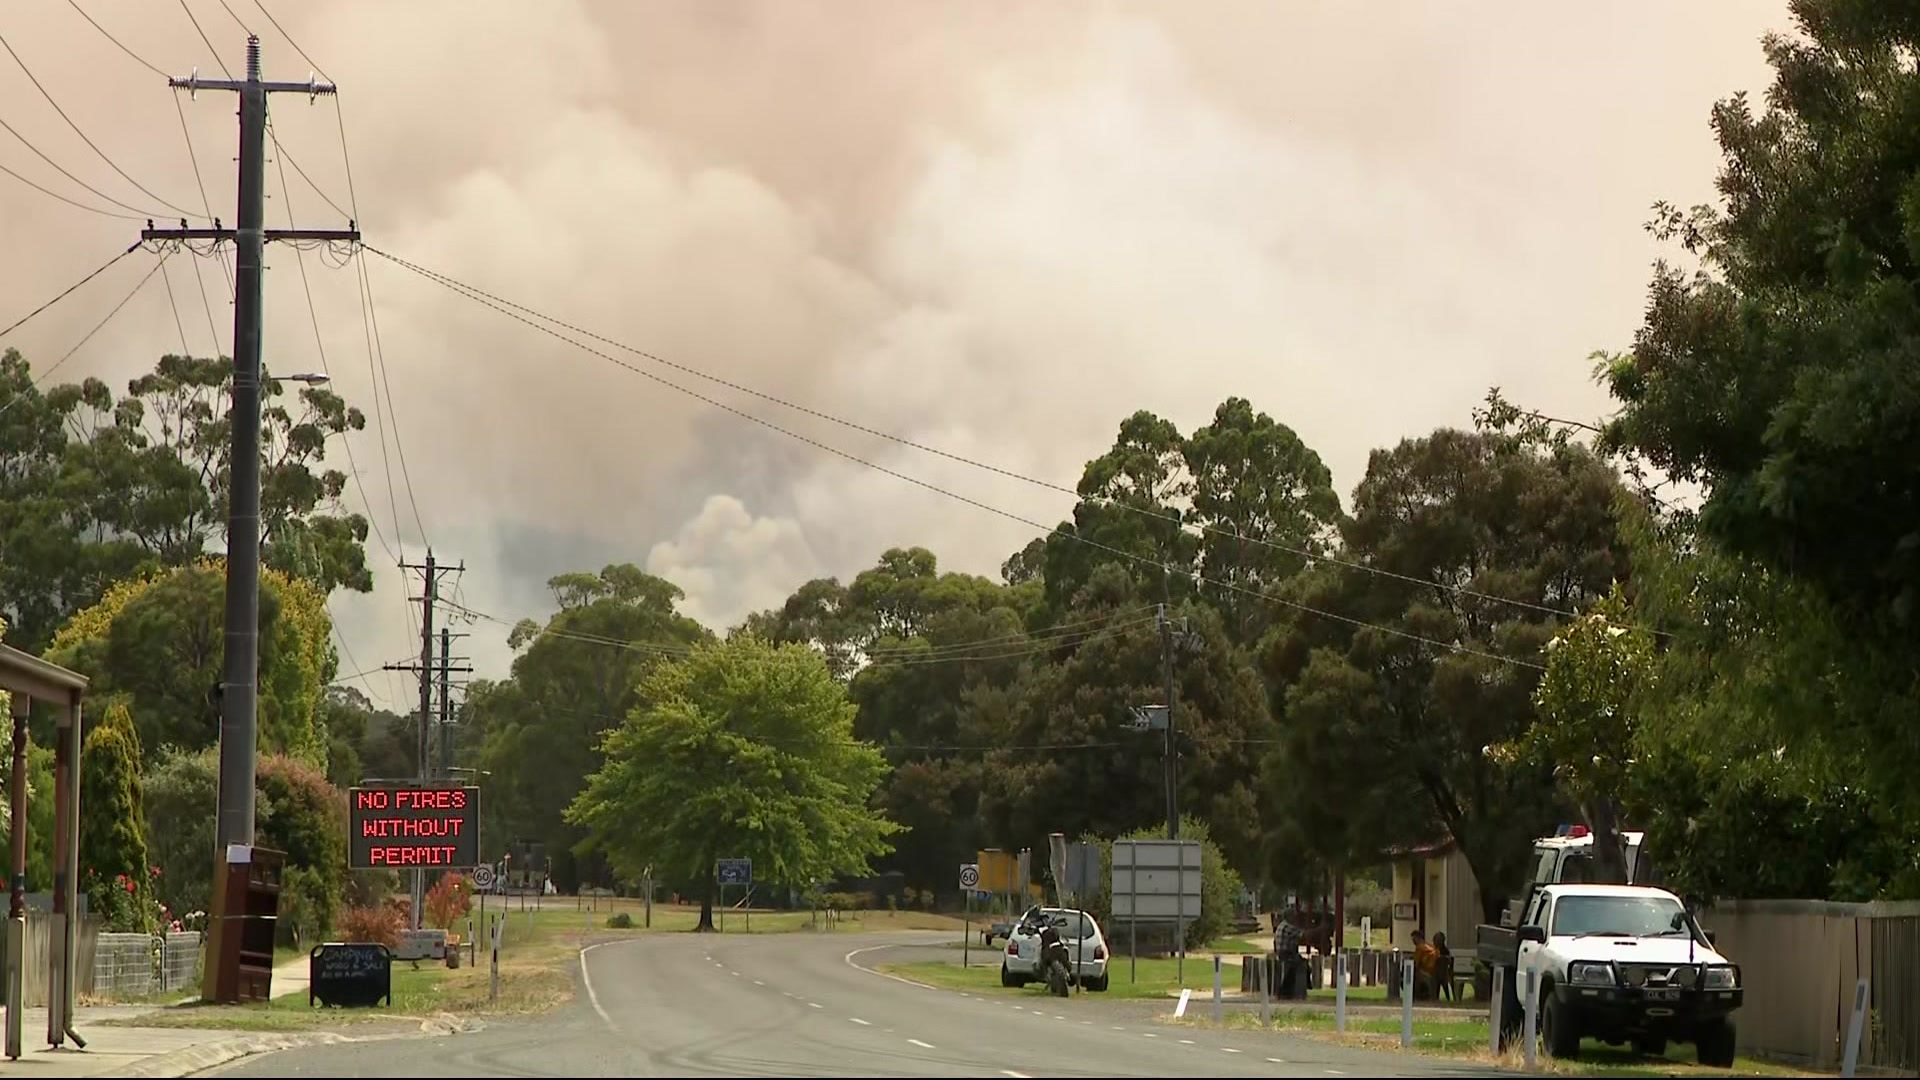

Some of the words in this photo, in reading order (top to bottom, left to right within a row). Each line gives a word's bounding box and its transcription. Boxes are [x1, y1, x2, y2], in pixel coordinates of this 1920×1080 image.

[358, 792, 388, 809] NO
[396, 791, 466, 808] FIRES
[363, 819, 463, 837] WITHOUT
[370, 847, 456, 865] PERMIT
[476, 871, 489, 882] 60
[963, 872, 976, 882] 60
